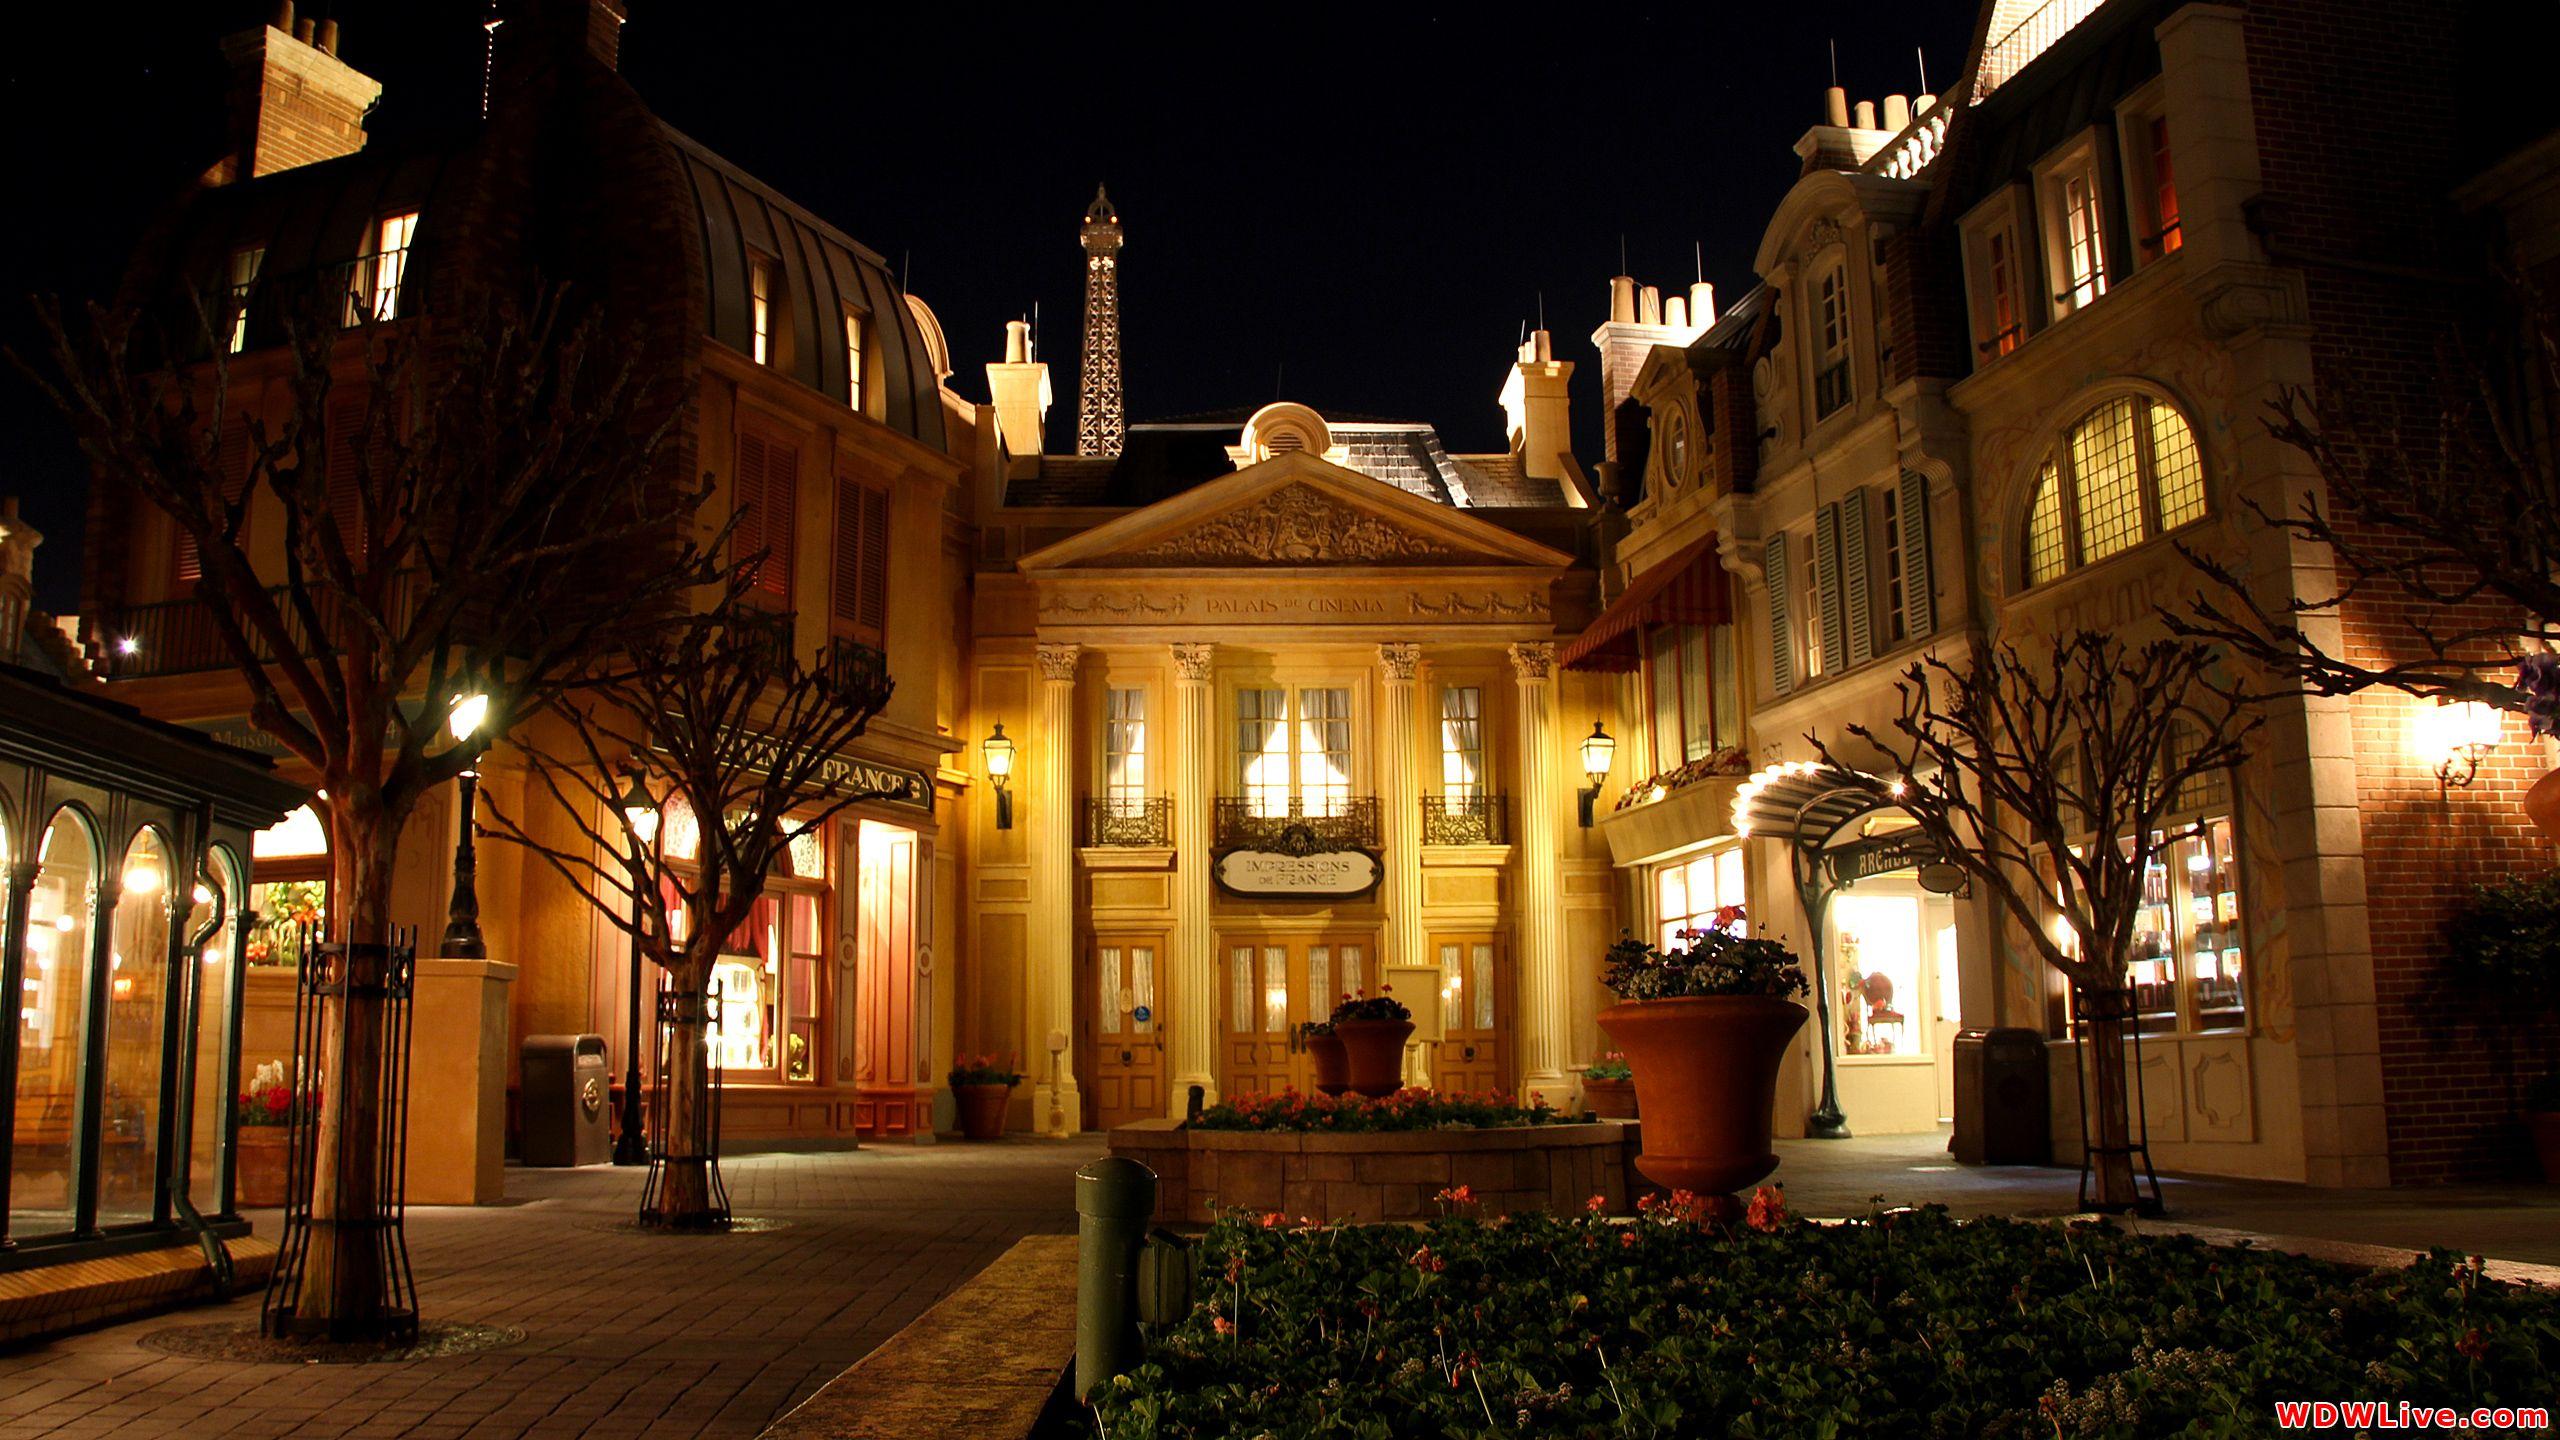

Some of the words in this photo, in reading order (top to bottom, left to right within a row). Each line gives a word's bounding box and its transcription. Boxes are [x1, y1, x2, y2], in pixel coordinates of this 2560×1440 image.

[1207, 600, 1278, 613] PALAIS
[1308, 600, 1384, 613] CINEMA
[1246, 860, 1350, 872] IMPRESSIONS
[1276, 874, 1336, 886] FRANCE
